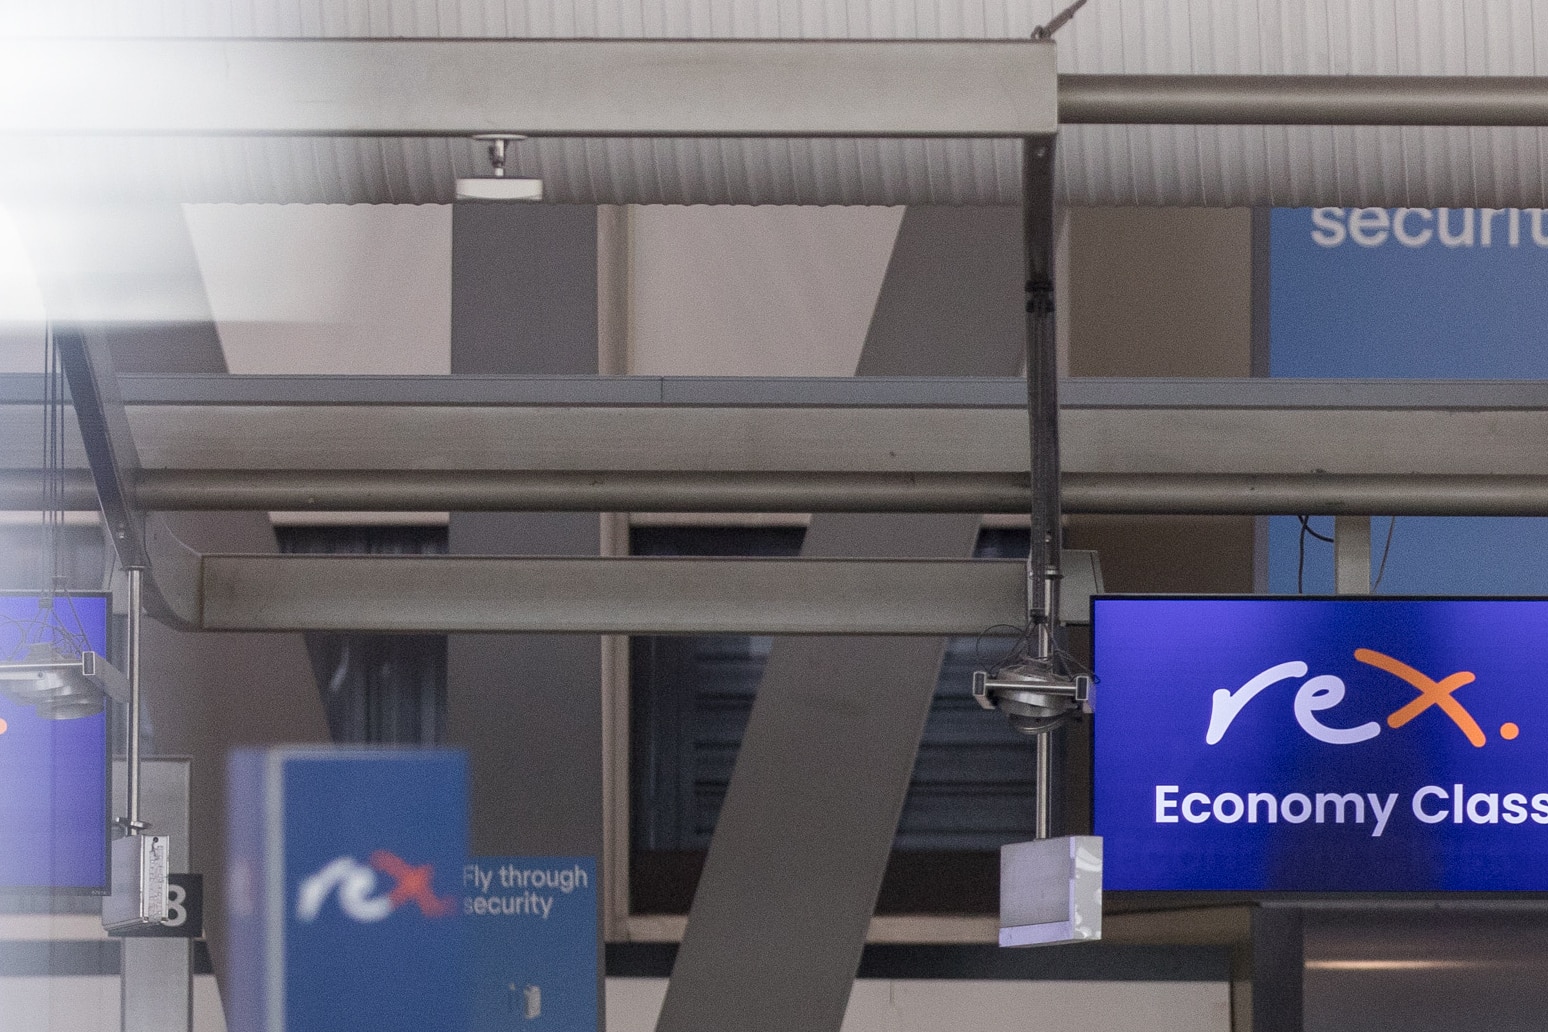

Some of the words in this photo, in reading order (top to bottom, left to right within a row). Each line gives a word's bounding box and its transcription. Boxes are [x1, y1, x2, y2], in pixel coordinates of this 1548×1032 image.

[1154, 785, 1399, 837] Economy
[463, 864, 492, 893] Fly
[499, 863, 589, 893] through
[463, 890, 553, 919] security
